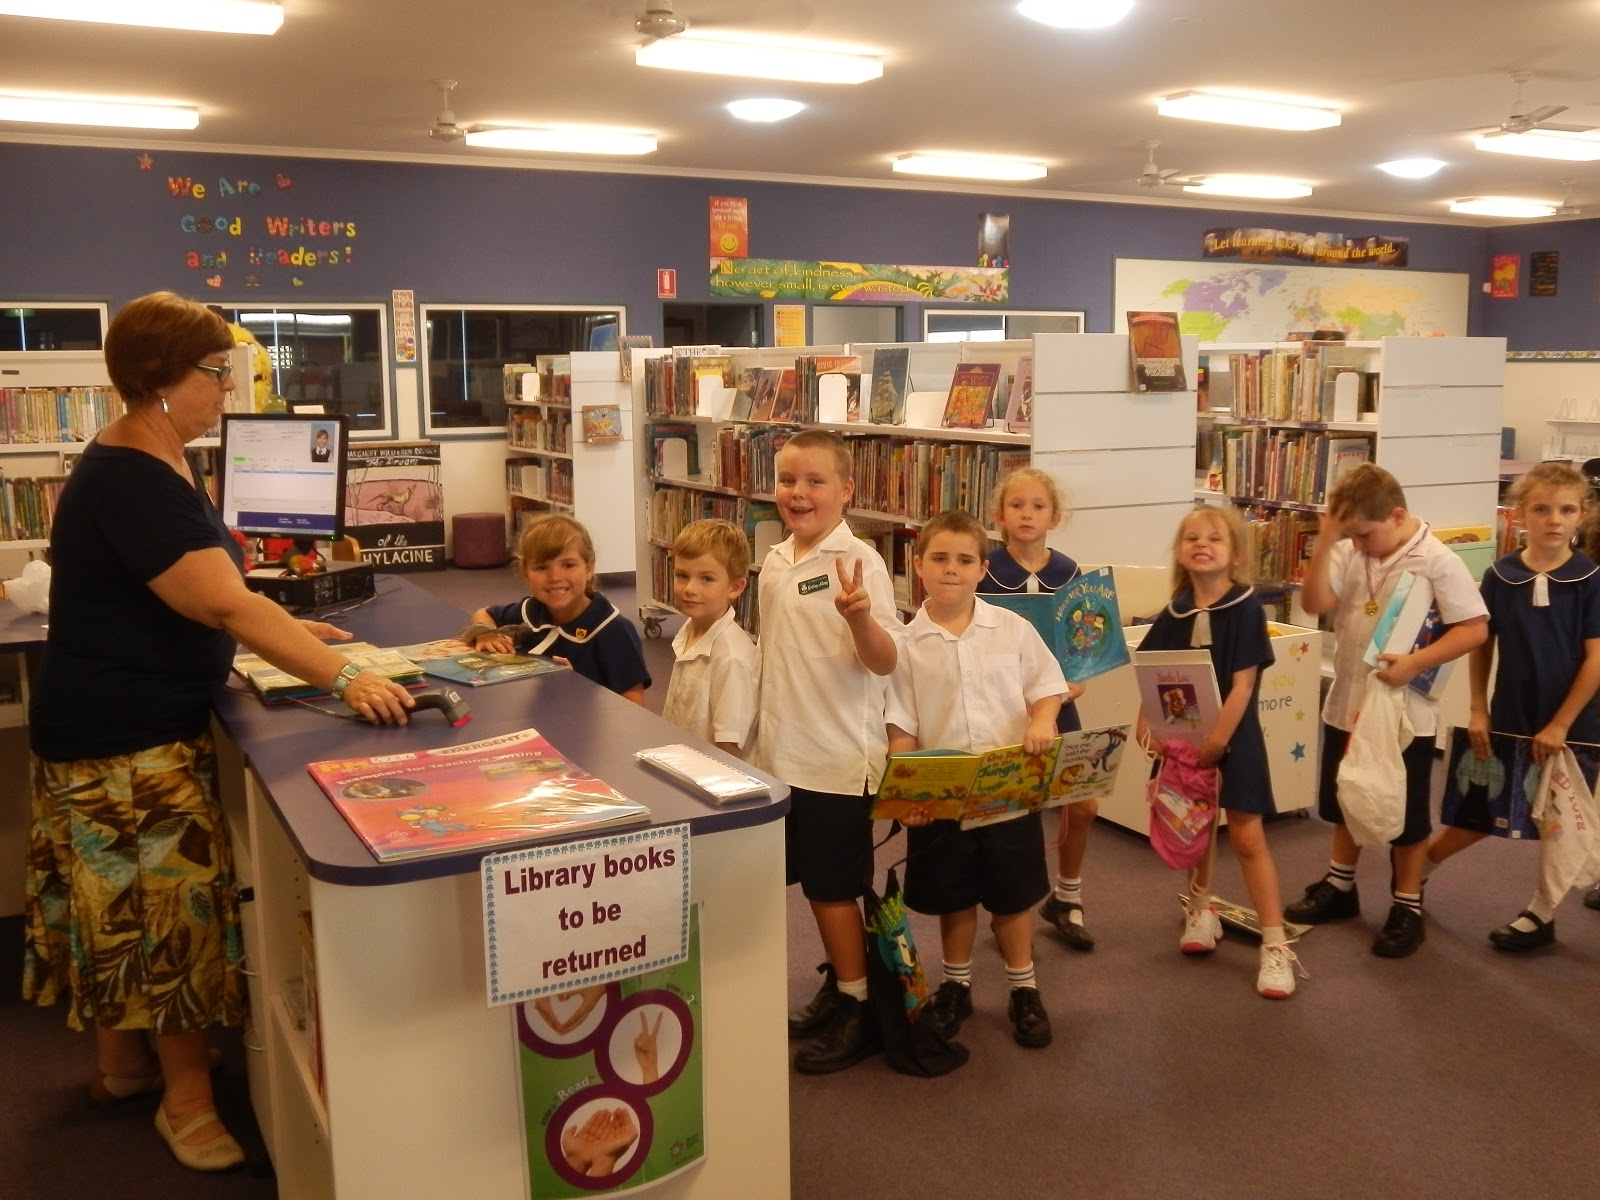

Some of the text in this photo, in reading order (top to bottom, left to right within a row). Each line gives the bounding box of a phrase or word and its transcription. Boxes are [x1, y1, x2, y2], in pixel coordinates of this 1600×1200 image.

[167, 176, 260, 199] We Are
[180, 215, 356, 237] Good Writers
[1213, 238, 1229, 250] Let
[1232, 234, 1273, 250] learning
[1275, 237, 1296, 250] take
[1297, 243, 1315, 255] you
[1317, 246, 1349, 259] around
[1351, 246, 1366, 258] the
[186, 250, 228, 268] and
[720, 260, 857, 280] No act of kindness,
[715, 275, 774, 289] however
[778, 278, 815, 291] small,
[818, 280, 828, 291] is
[831, 282, 860, 292] ever
[385, 457, 418, 466] Dream
[377, 533, 408, 547] of the
[361, 549, 434, 565] HYLACINE
[441, 734, 521, 756] EMERGENT
[406, 764, 426, 773] for
[430, 755, 489, 770] Teaching
[504, 846, 676, 895] Library books
[558, 901, 622, 931] to be
[542, 935, 647, 979] returned
[556, 1075, 590, 1101] Read
